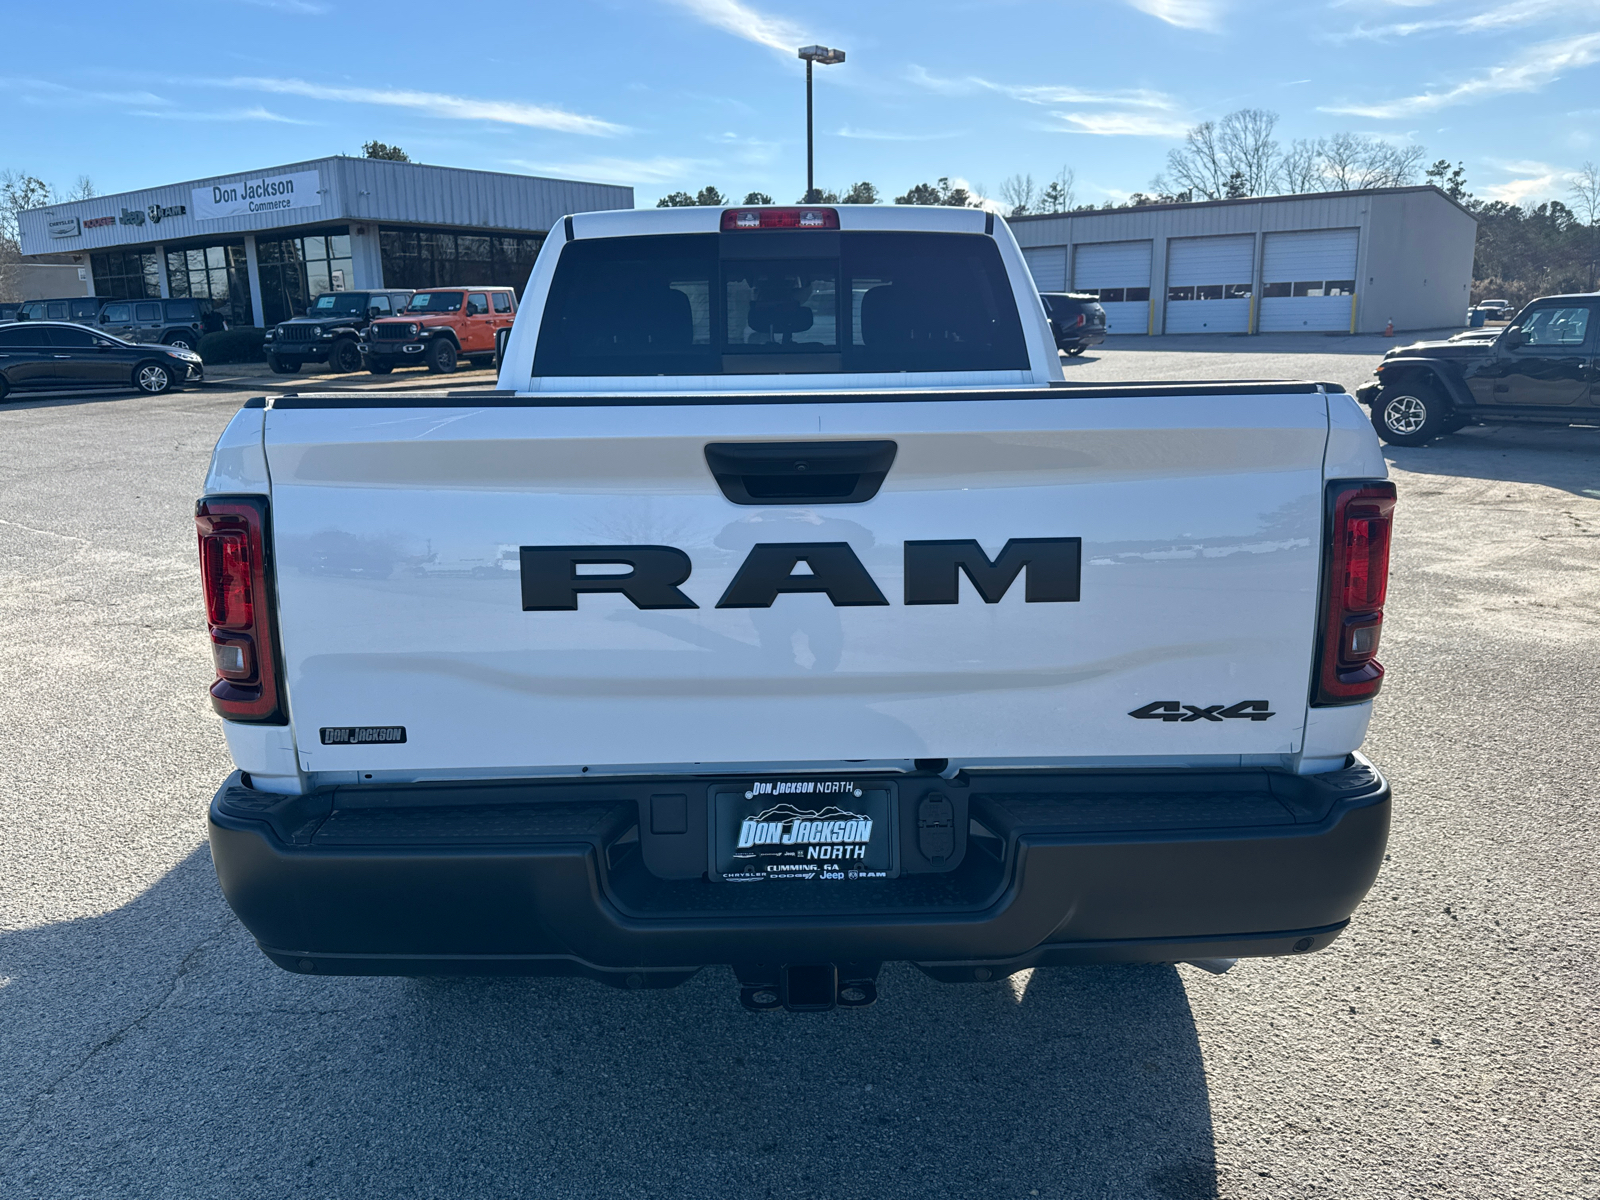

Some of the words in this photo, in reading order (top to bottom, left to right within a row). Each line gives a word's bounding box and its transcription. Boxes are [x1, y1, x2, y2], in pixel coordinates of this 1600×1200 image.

[212, 185, 237, 204] Don
[241, 178, 295, 200] Jackson
[249, 199, 291, 212] Commerce
[49, 219, 75, 227] CHRYSLER
[520, 537, 1082, 611] RAM
[1127, 700, 1276, 722] 4x4
[349, 728, 402, 743] JACKSON
[773, 782, 814, 795] JACKSON
[816, 782, 853, 793] NORTH
[782, 820, 873, 844] JACKSON
[807, 846, 865, 859] NORTH
[819, 870, 845, 880] Jeep
